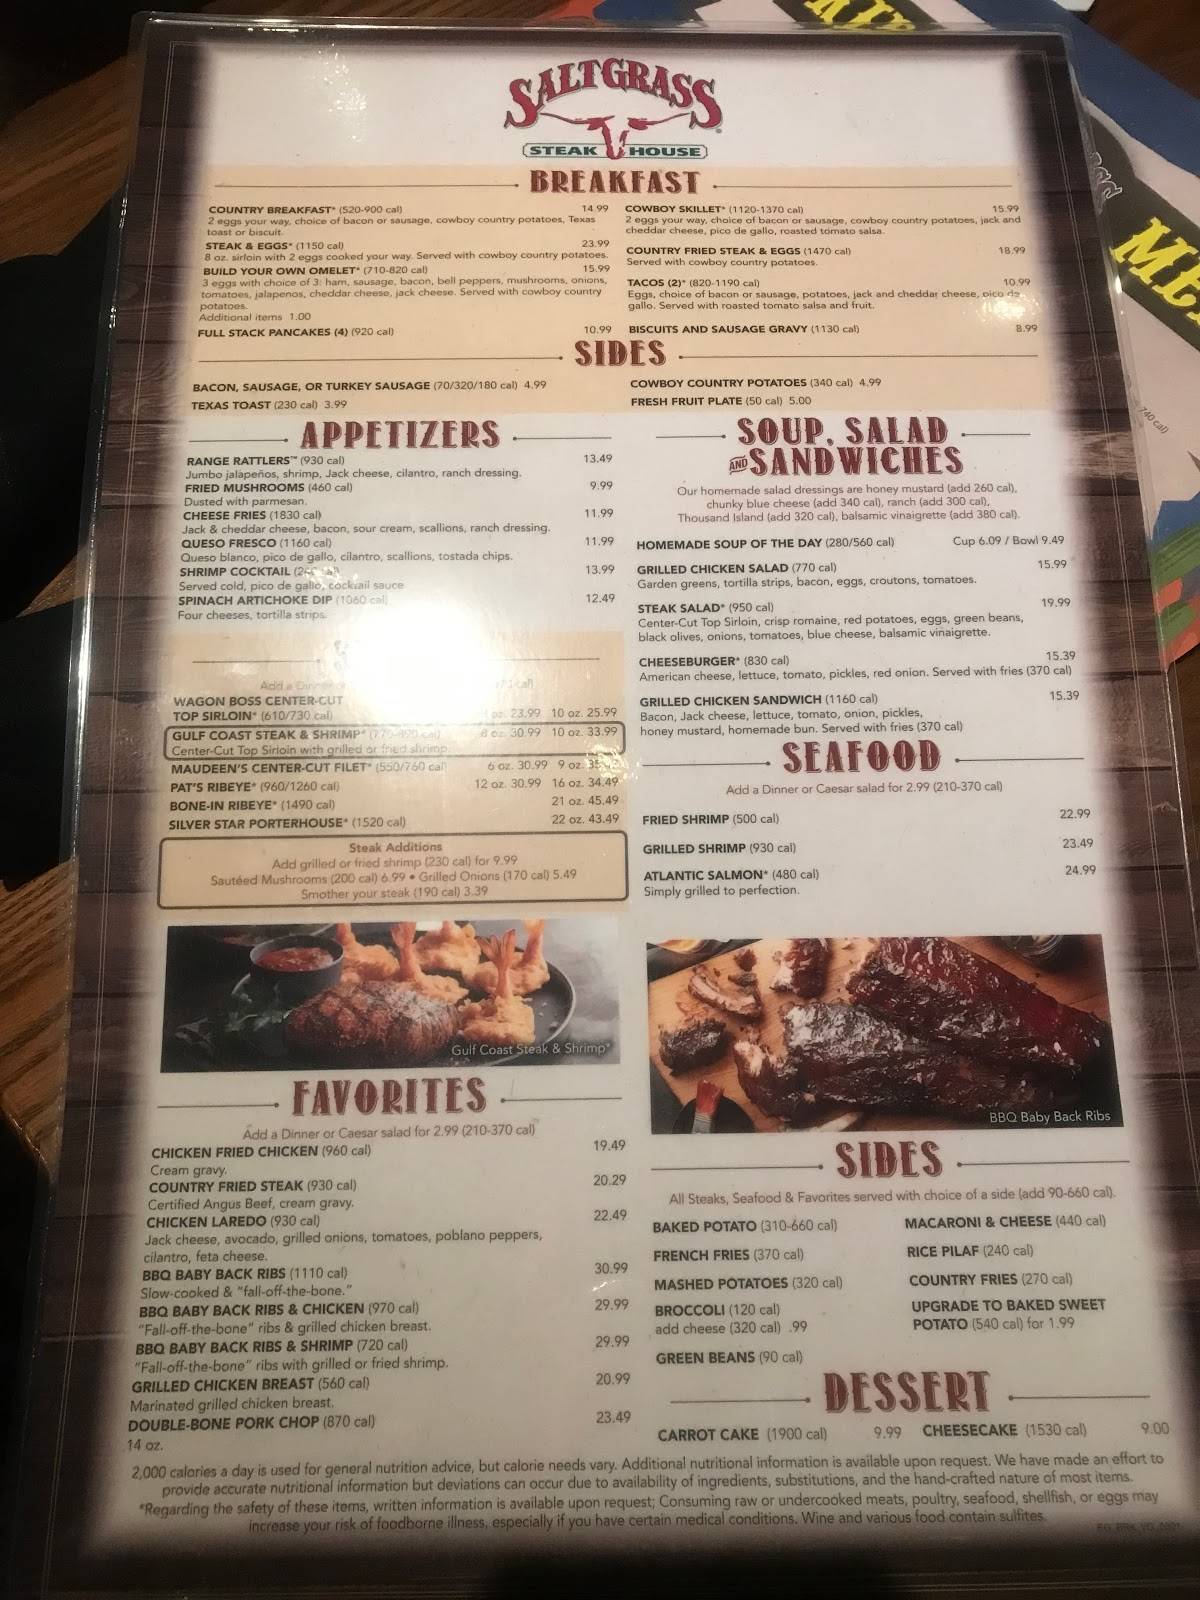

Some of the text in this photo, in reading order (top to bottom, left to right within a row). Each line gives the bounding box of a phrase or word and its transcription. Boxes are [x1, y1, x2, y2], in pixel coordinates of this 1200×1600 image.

[504, 58, 722, 129] SALTGRASS
[530, 146, 701, 156] STEAK HOUSE
[530, 169, 701, 194] BREAKFAST
[208, 205, 264, 214] COUNTRY
[338, 205, 383, 214] (520-900
[385, 205, 402, 214] cal)
[582, 204, 609, 212] 14.99
[624, 204, 676, 213] COWBOY
[729, 205, 784, 214] (1120-1370
[787, 206, 803, 214] cal)
[992, 204, 1019, 213] 15.99
[206, 228, 232, 236] toast
[205, 242, 242, 250] STEAK
[245, 242, 253, 250] &
[296, 241, 324, 251] (1150
[327, 241, 344, 250] cal)
[581, 239, 610, 248] 23.99
[626, 257, 818, 268] Served with cowboy country potatoes.
[198, 312, 311, 322] Additional items 1.00
[197, 327, 394, 338] FULL STACK PANCAKES (4) (920 cal)
[584, 325, 612, 334] 10.99
[628, 324, 859, 334] BISCUITS AND SAUSAGE GRAVY (1130 cal)
[1015, 323, 1038, 333] 8.99
[575, 339, 667, 367] SIDES
[631, 396, 811, 406] FRESH FRUIT PLATE (50 cal) 5.00
[300, 419, 500, 449] APPETIZERS
[845, 416, 948, 445] SALAD
[729, 445, 964, 476] AND SANDWICHES
[185, 482, 352, 493] FRIED MUSHROOMS (460 cal)
[590, 480, 613, 490] 9.99
[183, 496, 307, 508] Dusted with parmesan.
[181, 538, 332, 549] QUESO FRESCO (1160 cal)
[585, 536, 614, 546] 11.99
[744, 655, 768, 667] (830
[770, 655, 789, 666] cal)
[1046, 650, 1076, 661] 15.39
[640, 707, 923, 722] Bacon, Jack cheese, lettuce, tomato, onion, pickles,
[782, 739, 941, 774] SEAFOOD
[170, 782, 203, 793] PAT'S
[260, 781, 317, 792] (960/1260
[320, 781, 340, 792] cal)
[475, 777, 541, 789] 12 oz. 30.99
[169, 800, 224, 811] BONE-IN
[281, 799, 313, 810] (1490
[316, 799, 335, 809] cal)
[551, 794, 619, 806] 21 oz. 45.49
[642, 813, 779, 825] FRIED SHRIMP (500 cal)
[1059, 808, 1091, 819] 22.99
[349, 841, 442, 853] Steak Additions
[644, 883, 800, 899] Simply grilled to perfection.
[451, 1045, 476, 1056] Gulf
[479, 1045, 513, 1055] Coast
[517, 1043, 548, 1054] Steak
[552, 1043, 561, 1054] &
[292, 1076, 487, 1118] FAVORITES
[989, 1109, 1111, 1125] BBQ Baby Back Ribs
[835, 1140, 943, 1179] SIDES
[150, 1164, 227, 1179] Cream gravy.
[592, 1174, 627, 1186] 20.29
[149, 1179, 356, 1194] COUNTRY FRIED STEAK (930 cal)
[906, 1243, 1033, 1258] RICE PILAF (240 cal)
[655, 1320, 808, 1335] add cheese (320 cal) .99
[823, 1370, 990, 1413] DESSERT
[657, 1426, 827, 1442] CARROT CAKE (1900 cal)
[873, 1425, 902, 1439] 9.99
[922, 1423, 1086, 1438] CHEESECAKE (1530 cal)
[1140, 1421, 1170, 1435] 9.00
[127, 1438, 163, 1451] 14 oz.
